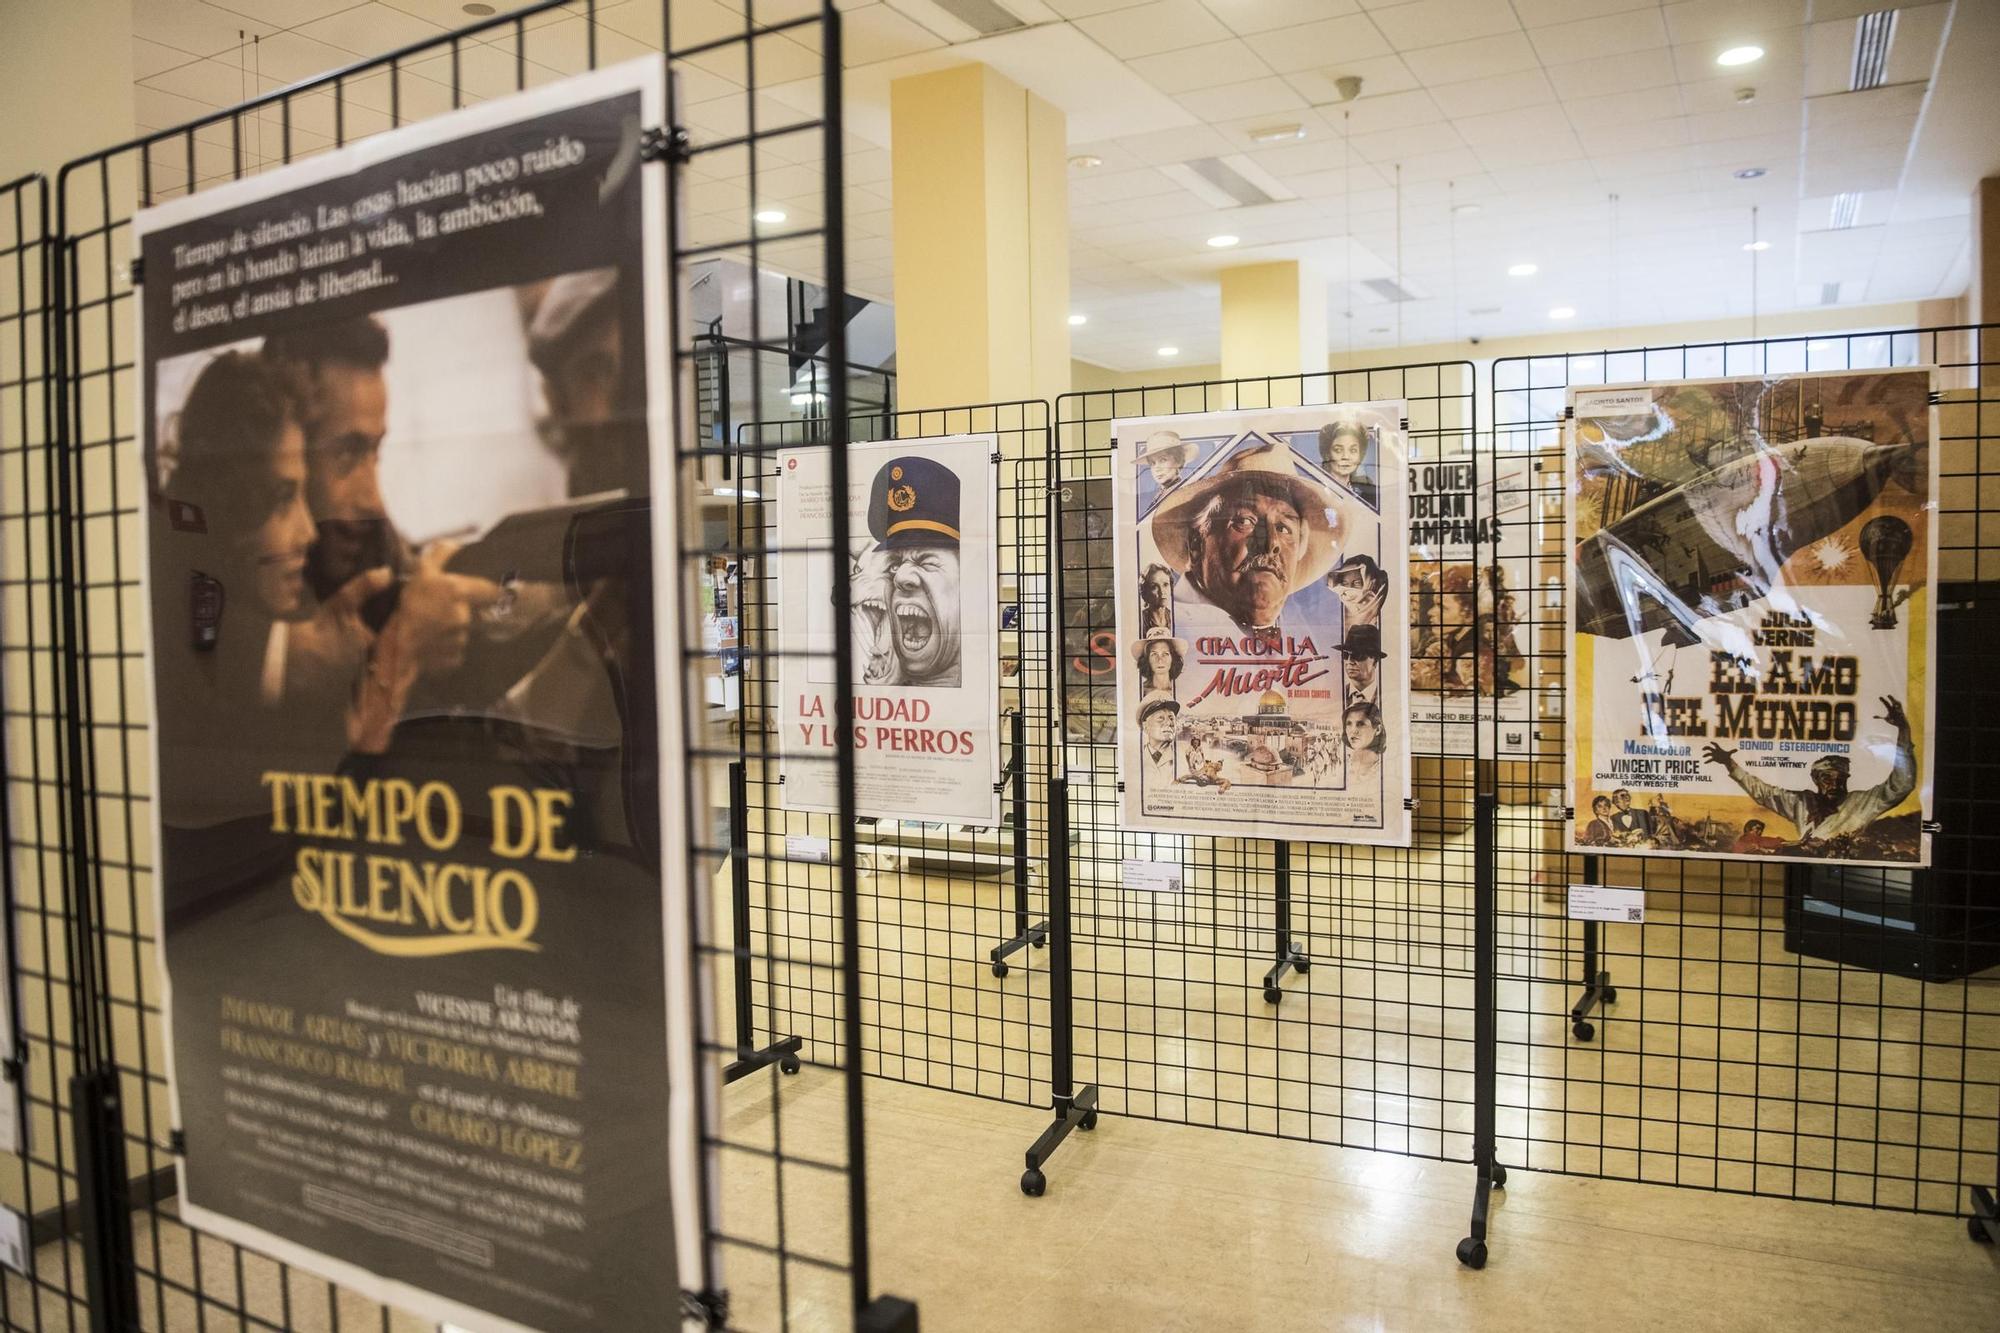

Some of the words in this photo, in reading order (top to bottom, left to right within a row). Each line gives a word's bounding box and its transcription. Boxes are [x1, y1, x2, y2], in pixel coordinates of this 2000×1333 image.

[317, 205, 348, 231] Las
[465, 156, 519, 194] poco
[521, 135, 586, 176] ruido
[416, 210, 437, 240] la
[1410, 518, 1502, 546] AMPANAS
[1196, 635, 1239, 655] CITA
[1240, 636, 1283, 655] CON
[1287, 635, 1318, 655] LA
[1752, 629, 1815, 647] VERNE
[1710, 650, 1756, 694] EL
[1762, 649, 1859, 695] AMO
[800, 694, 824, 718] LA
[834, 696, 930, 722] IUDAD
[1714, 694, 1857, 741] MUNDO
[800, 724, 813, 745] Y
[876, 727, 974, 755] PERROS
[1740, 740, 1773, 750] SONIDO
[1780, 741, 1850, 753] ESTEREOFONICO
[1610, 759, 1662, 773] VINCENT
[1665, 760, 1700, 774] PRICE
[261, 770, 462, 851] TIEMPO
[488, 785, 577, 863] DE
[291, 846, 542, 957] SILENCIO
